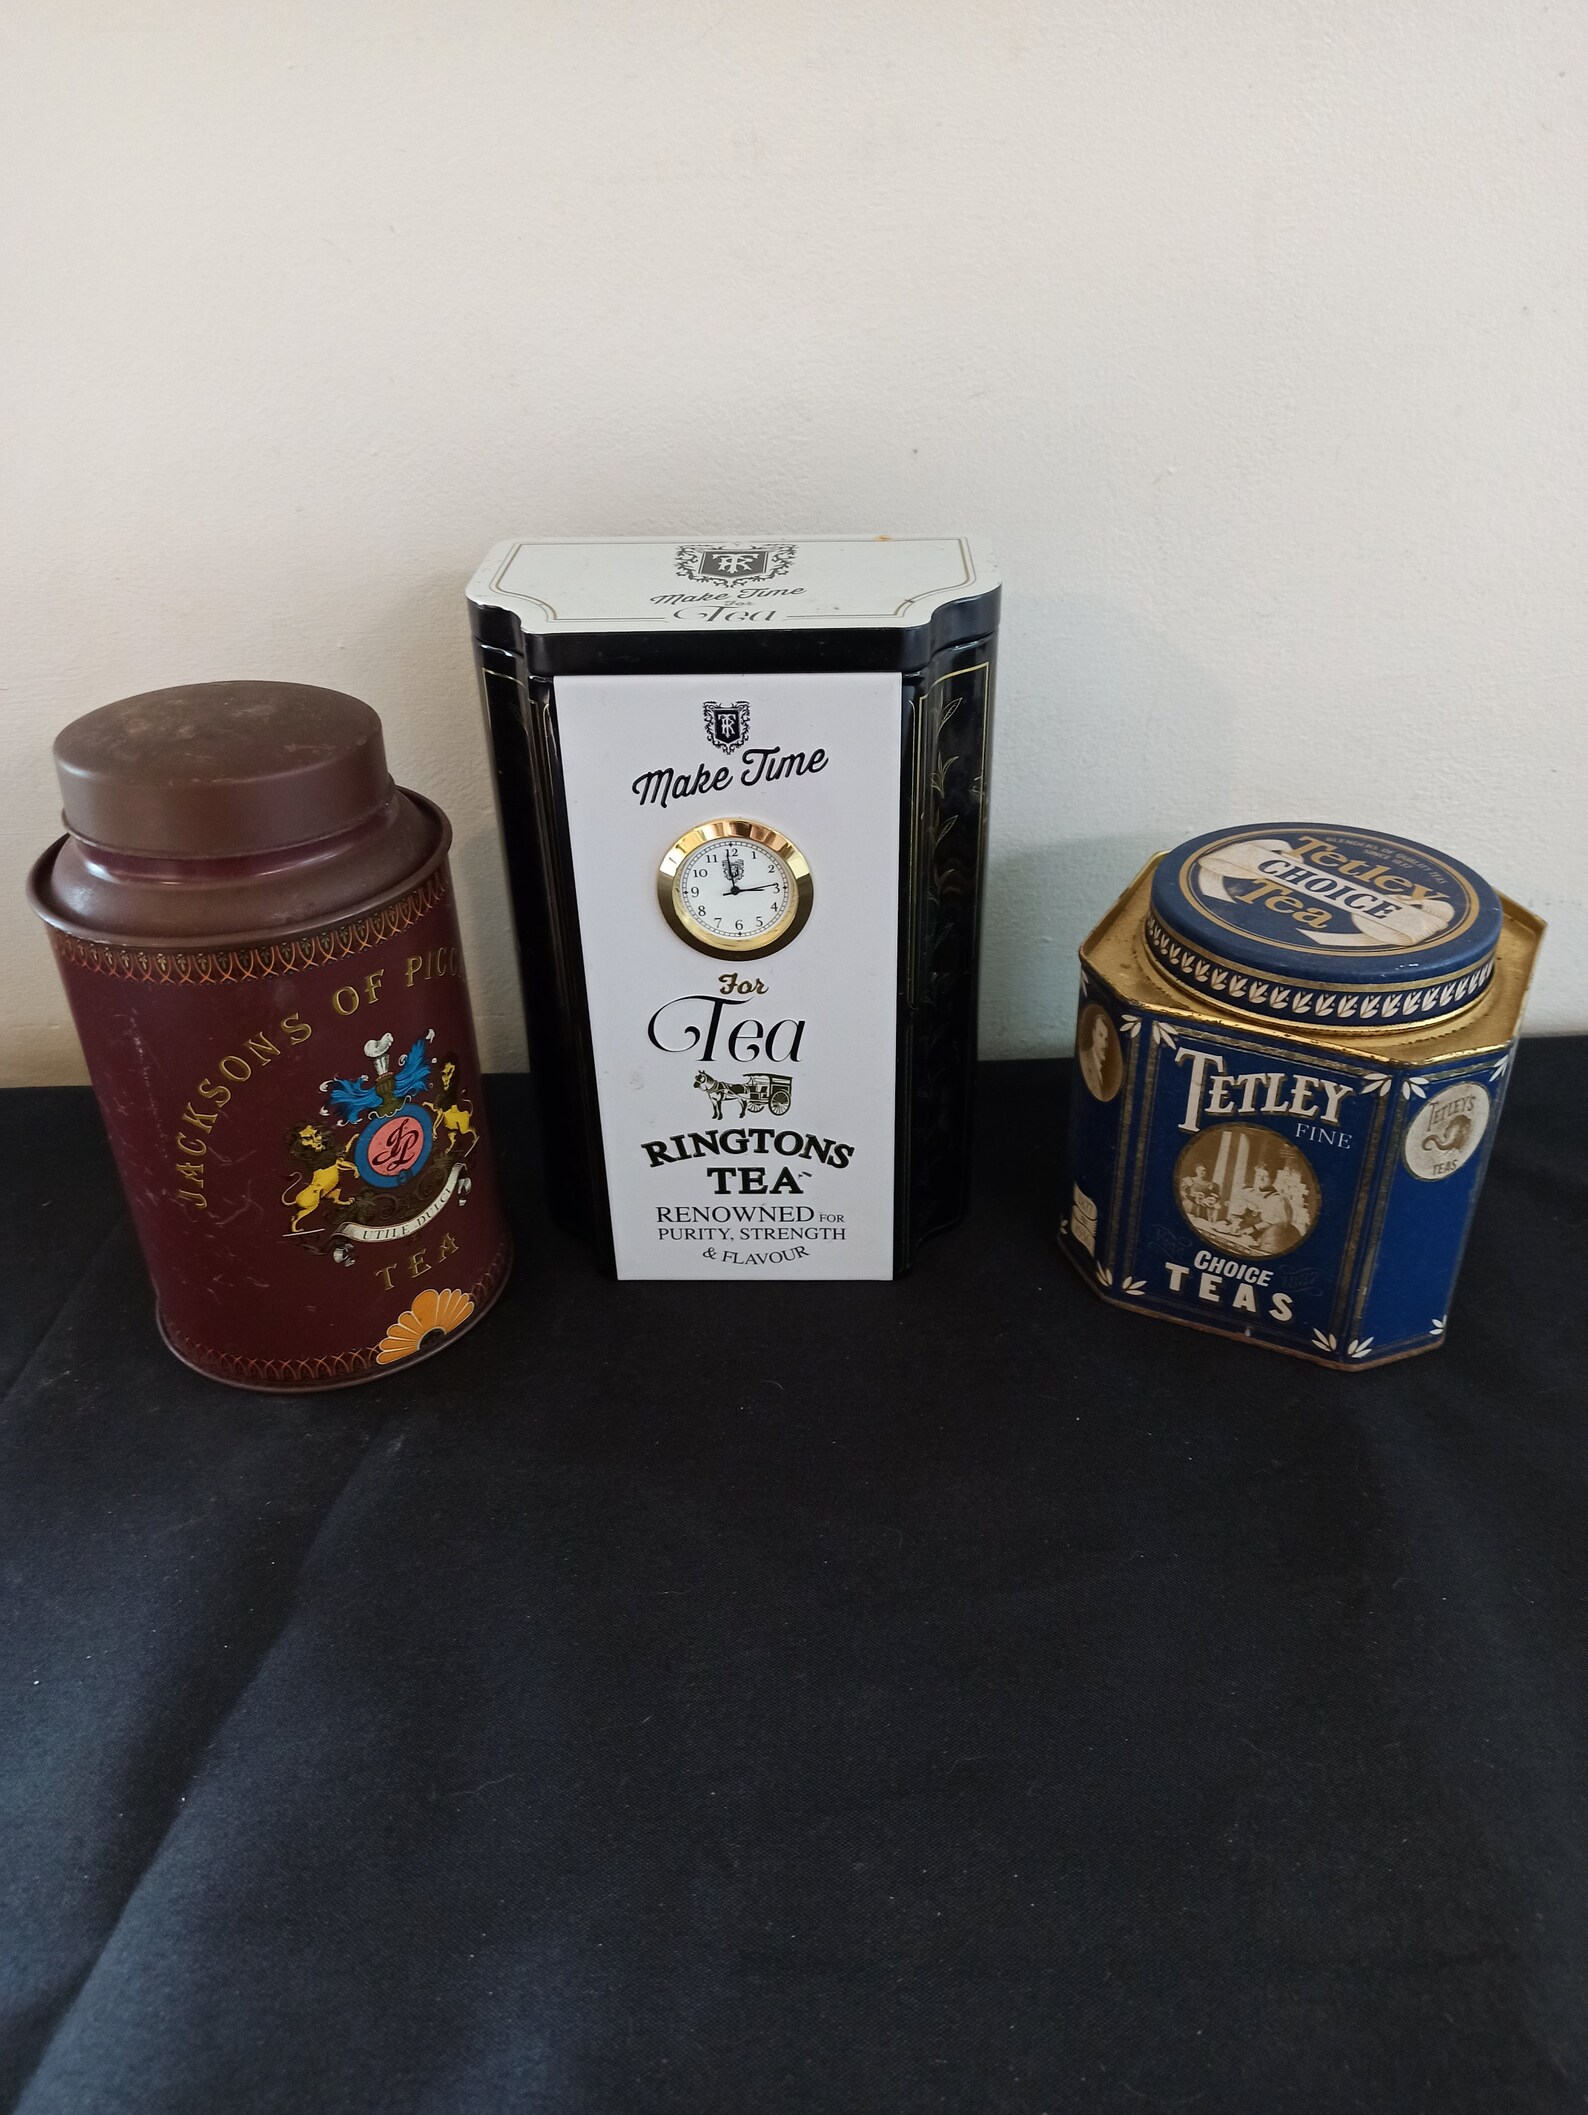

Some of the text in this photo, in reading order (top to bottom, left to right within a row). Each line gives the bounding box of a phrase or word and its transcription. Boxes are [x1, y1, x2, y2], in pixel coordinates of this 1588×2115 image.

[650, 587, 807, 605] Make Time
[673, 606, 776, 622] Tea
[632, 746, 829, 808] Make Time
[706, 854, 718, 863] 11
[725, 848, 738, 857] 12
[752, 851, 757, 859] 1
[693, 869, 708, 878] 10
[768, 865, 775, 873] 2
[1289, 836, 1452, 909] Tetley
[690, 886, 699, 898] 9
[773, 883, 780, 894] 3
[1258, 859, 1404, 920] CHOICE
[698, 905, 706, 916] 8
[770, 902, 778, 912] 4
[1236, 878, 1333, 929] Tea
[714, 917, 722, 928] 7
[735, 919, 743, 930] 6
[756, 916, 763, 927] 5
[718, 972, 769, 995] For
[648, 995, 806, 1063] Tea
[177, 945, 462, 1209] JACKSONS OF PICC
[1174, 1047, 1354, 1133] TETLEY
[1295, 1122, 1353, 1150] FINE
[641, 1128, 855, 1169] RINGTONS
[1432, 1159, 1458, 1176] TEAS
[656, 1205, 845, 1223] RENOWNED FOR
[658, 1227, 846, 1243] PURITY, STRENGTH
[376, 1232, 460, 1291] TEA
[702, 1245, 810, 1265] & FLAVOUR
[1194, 1250, 1274, 1288] CHOICE
[1165, 1262, 1294, 1322] TEAS
